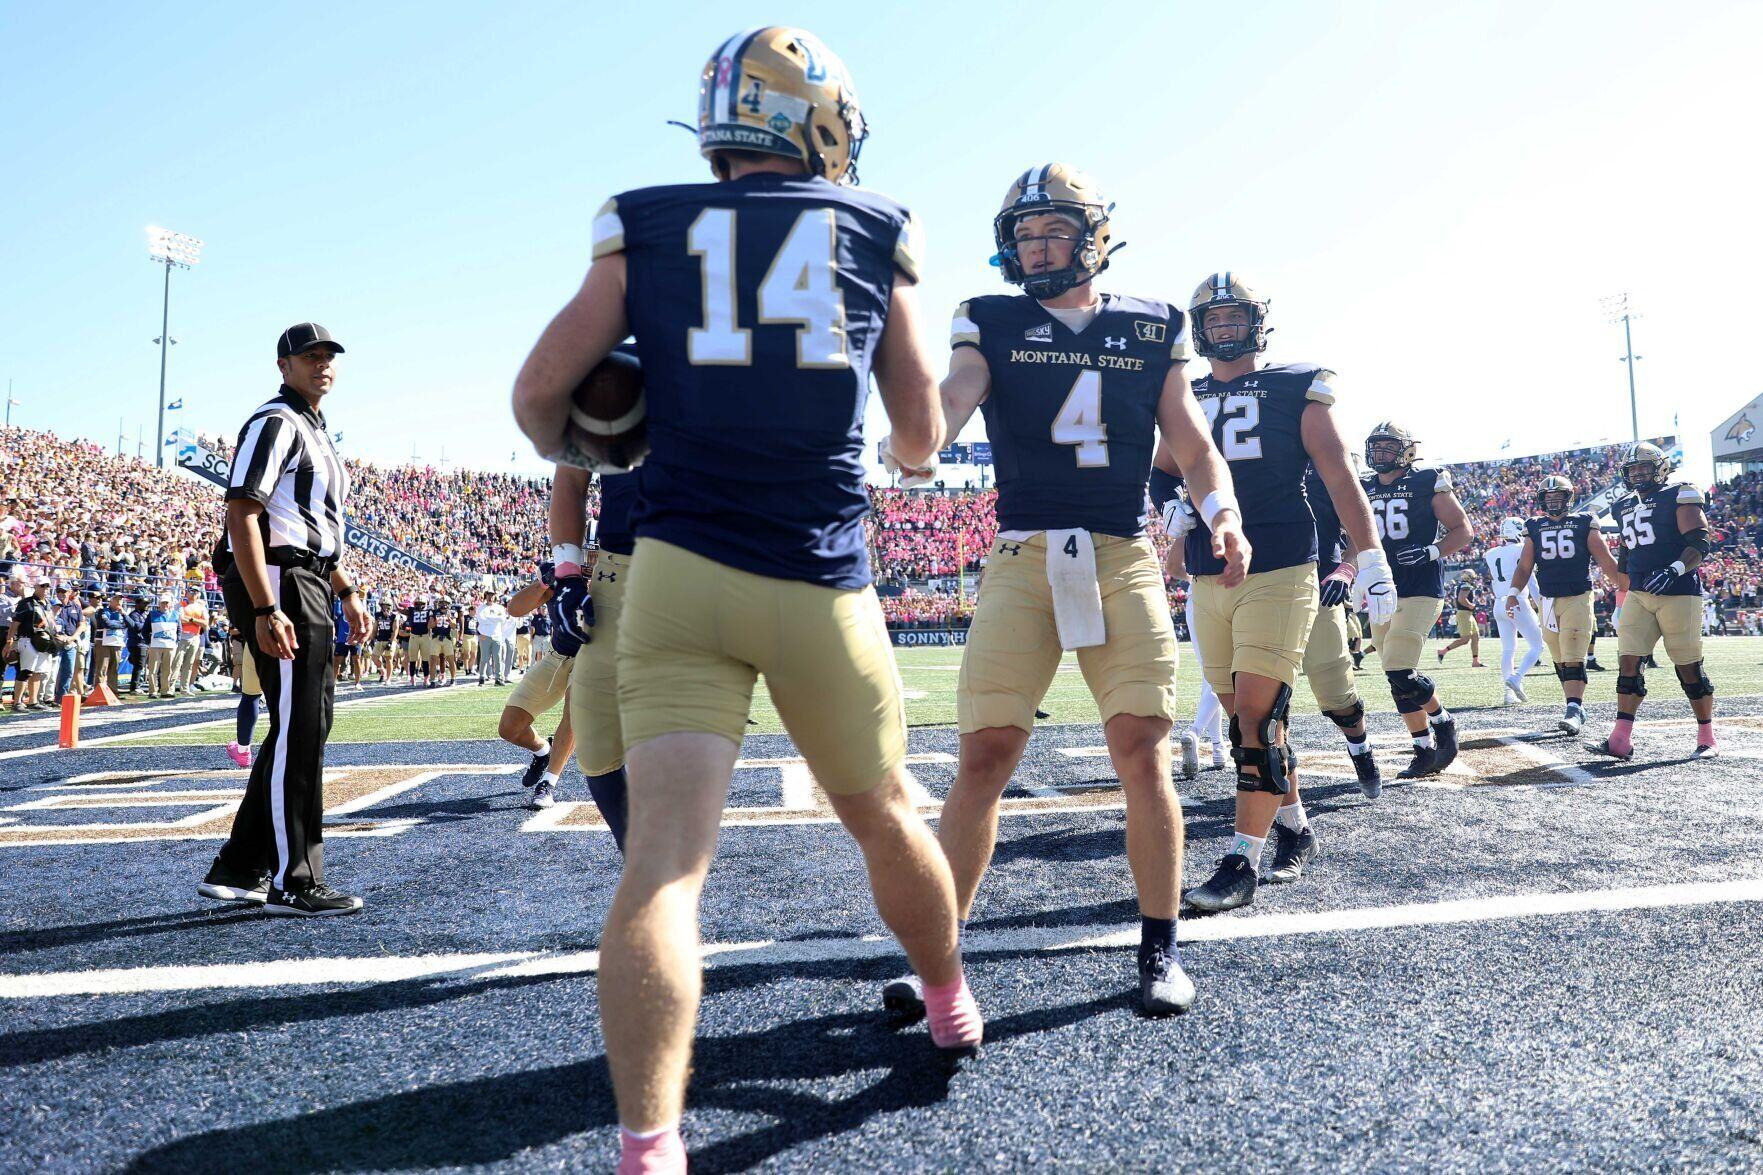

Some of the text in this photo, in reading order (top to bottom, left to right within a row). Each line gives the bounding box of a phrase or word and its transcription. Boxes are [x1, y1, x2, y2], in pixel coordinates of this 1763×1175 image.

[734, 130, 774, 146] STATE
[687, 207, 848, 369] 14
[1143, 324, 1156, 339] 41
[1010, 350, 1145, 371] MONTANA STATE
[1236, 390, 1268, 398] STATE
[1051, 369, 1110, 469] 4
[1198, 396, 1263, 462] 72
[202, 453, 230, 480] SC
[1371, 498, 1410, 540] 66
[1621, 510, 1656, 550] 55
[348, 529, 387, 557] CATS
[1063, 534, 1079, 558] 4
[1540, 528, 1576, 560] 56
[413, 611, 428, 623] 22
[898, 632, 967, 644] SONNY H
